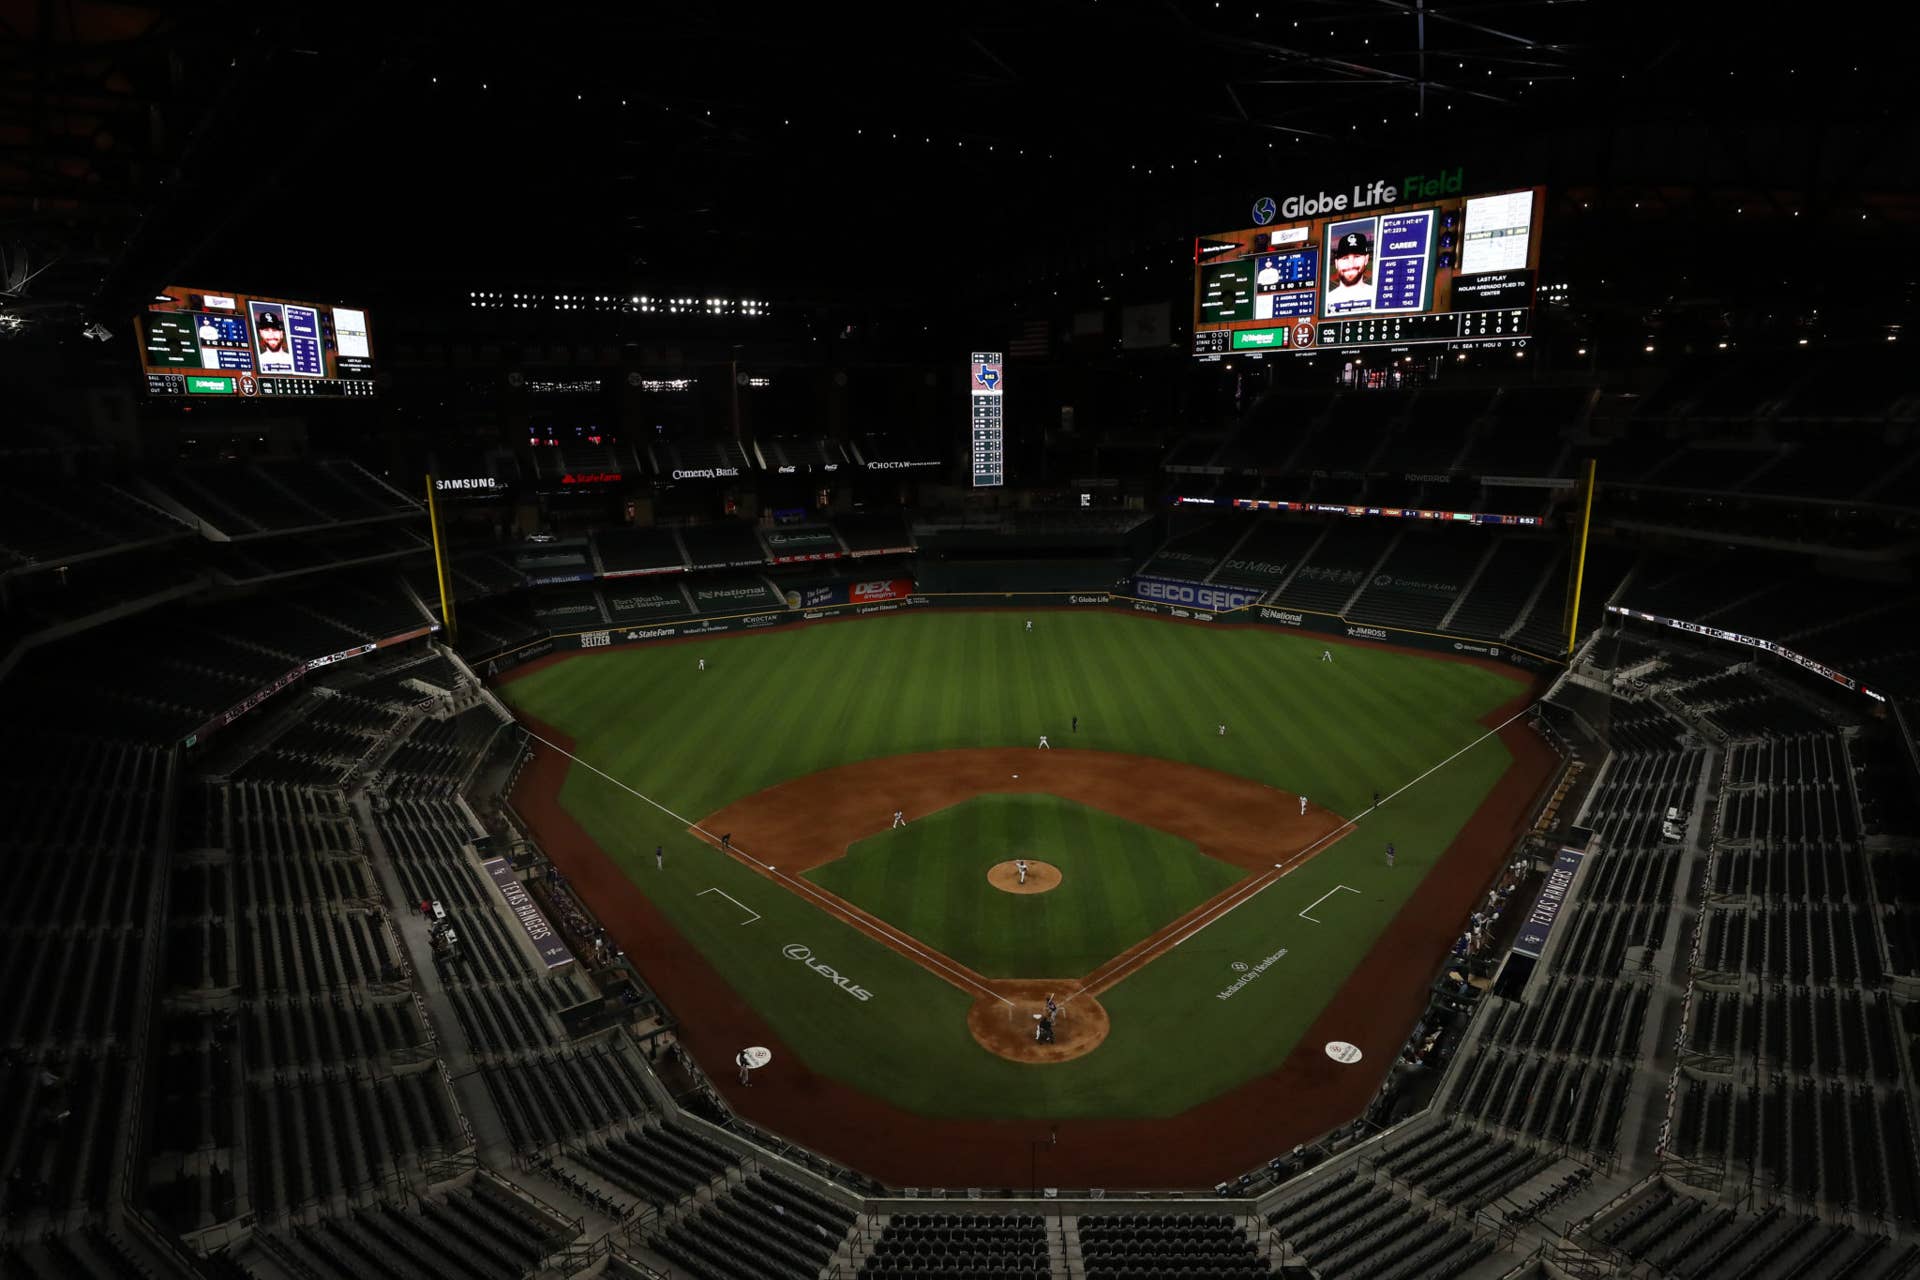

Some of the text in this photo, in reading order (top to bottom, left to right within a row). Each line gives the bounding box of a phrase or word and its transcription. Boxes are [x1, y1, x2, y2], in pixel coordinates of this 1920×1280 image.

[1281, 166, 1464, 219] Globe Life Field
[1389, 241, 1418, 250] CAREER
[871, 461, 910, 469] CHOCTAW
[716, 467, 739, 476] Bank
[436, 477, 496, 490] SAMSUNG
[714, 586, 764, 598] National
[855, 580, 893, 595] DEX
[1137, 581, 1194, 602] GEICO
[746, 615, 777, 623] CHOCTAW
[1269, 611, 1302, 623] National
[581, 636, 611, 648] SELTZER
[1530, 868, 1573, 926] TEXAS RANGERS
[500, 880, 551, 940] TEXAS RANGERS
[805, 957, 875, 1001] LEXUS
